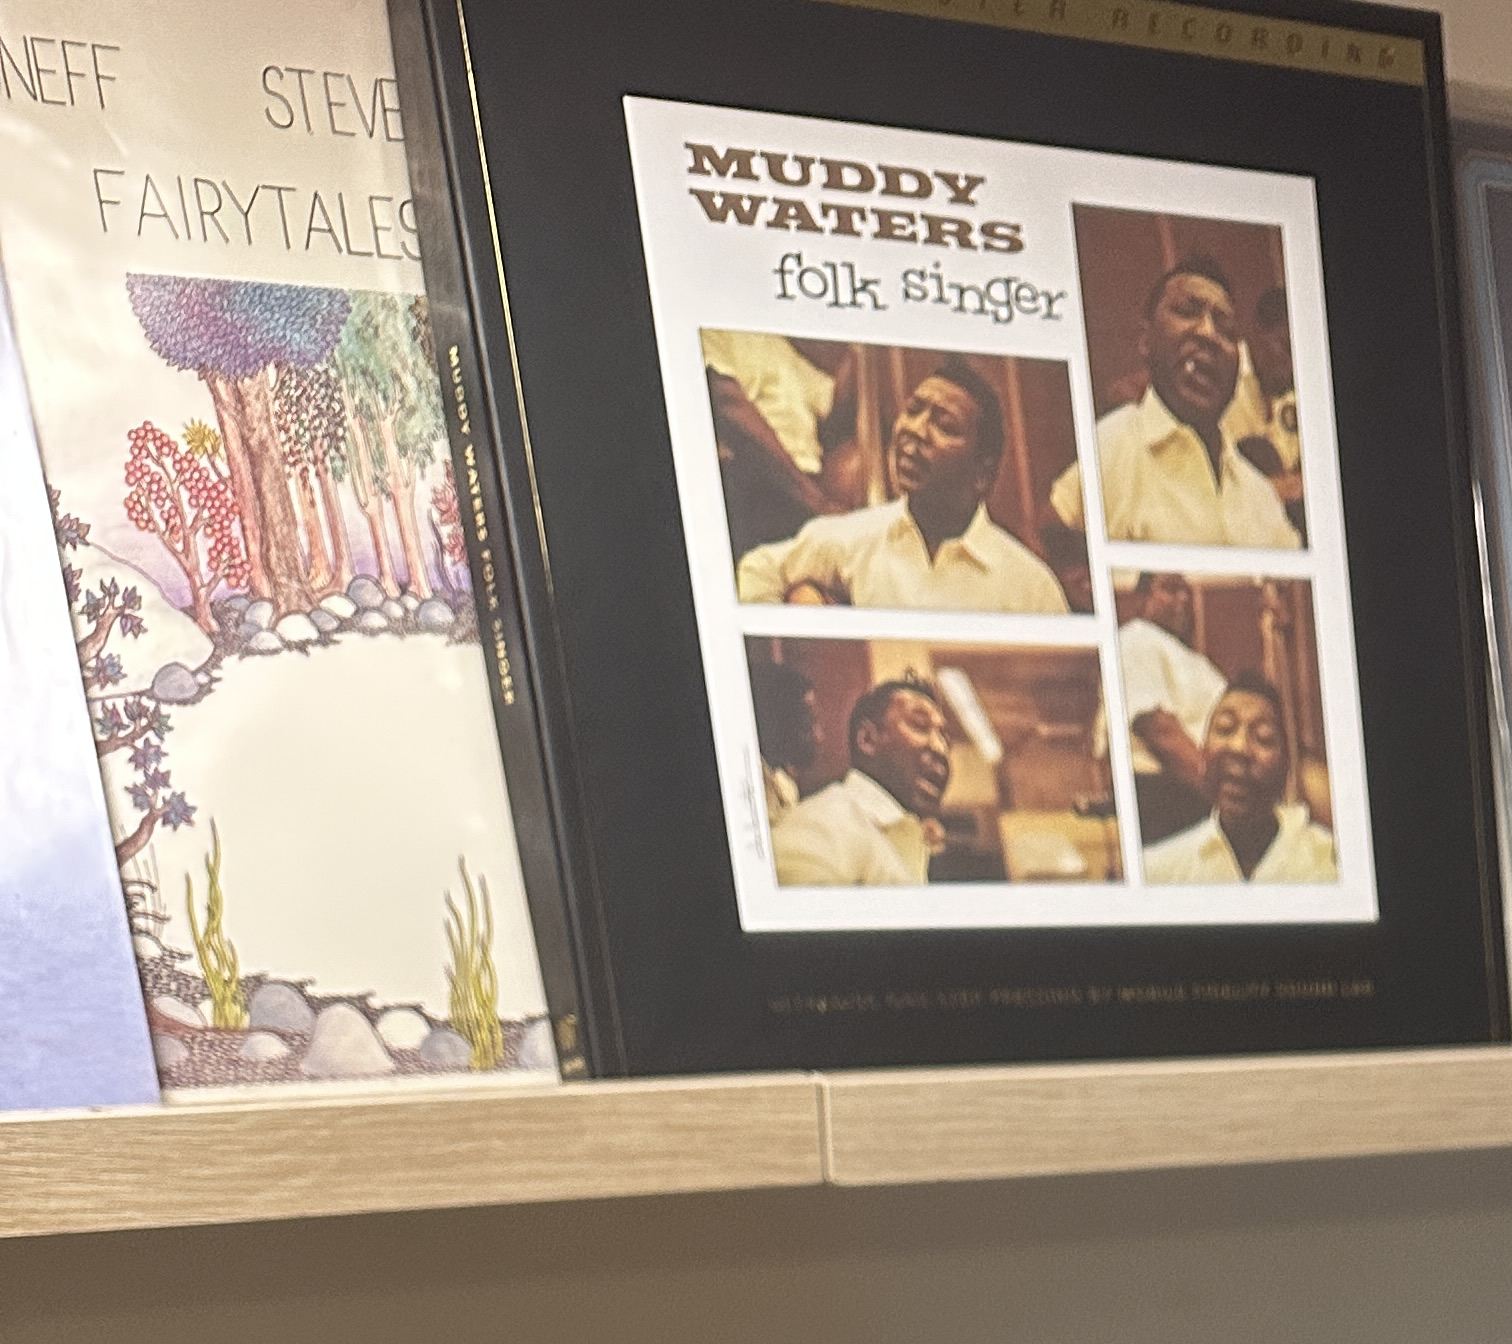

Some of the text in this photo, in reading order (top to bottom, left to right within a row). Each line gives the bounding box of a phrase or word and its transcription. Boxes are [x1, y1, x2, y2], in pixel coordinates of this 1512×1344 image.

[261, 64, 404, 142] STEVE
[683, 142, 986, 206] MUDDY
[93, 168, 424, 262] FAIRYTALES
[688, 187, 1026, 254] WATERS
[773, 251, 1069, 324] folk singer
[449, 344, 471, 435] MUDDY
[464, 443, 488, 542] WATERS
